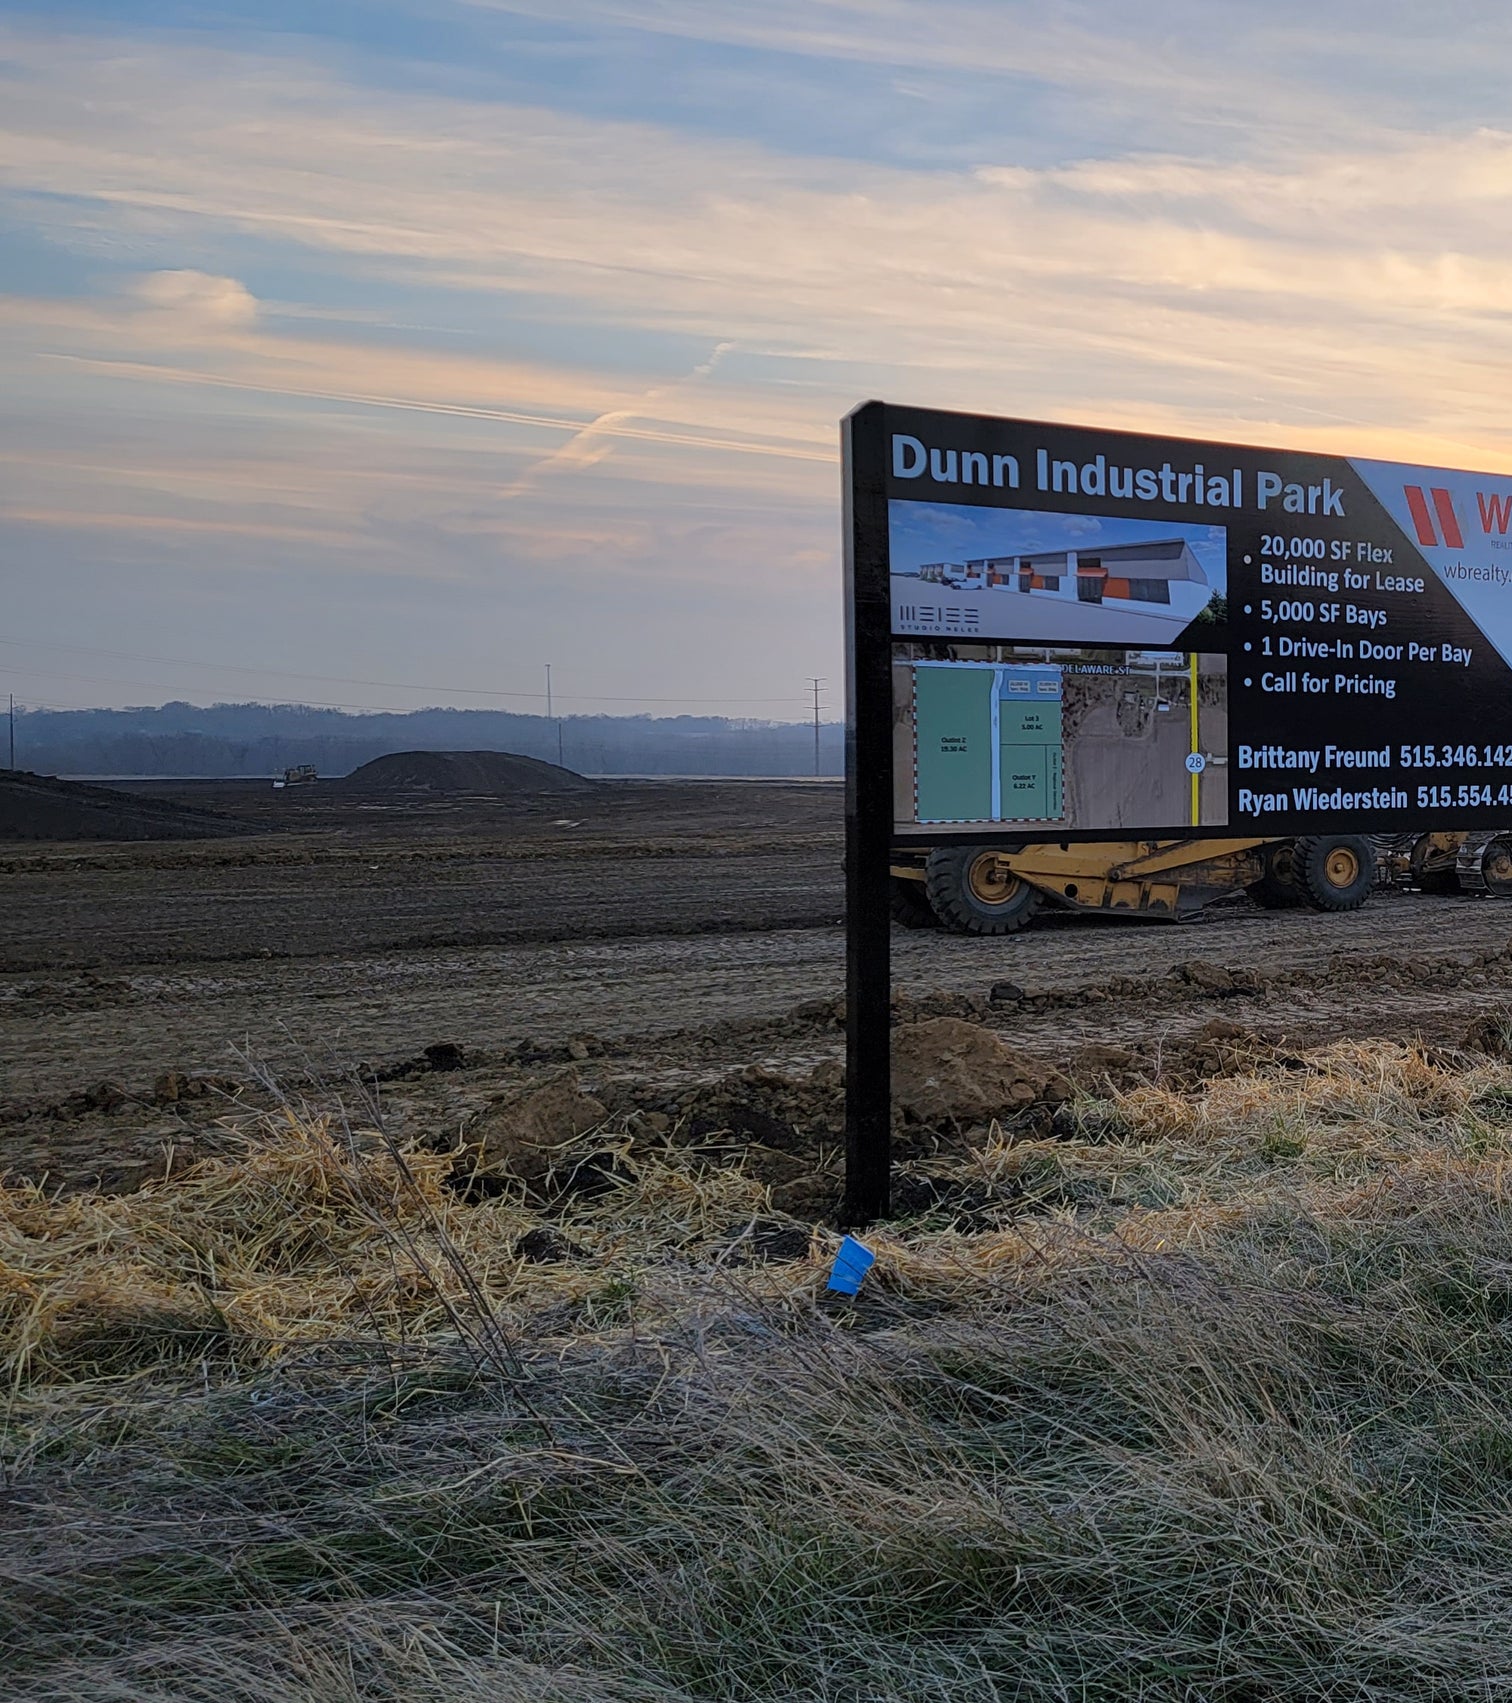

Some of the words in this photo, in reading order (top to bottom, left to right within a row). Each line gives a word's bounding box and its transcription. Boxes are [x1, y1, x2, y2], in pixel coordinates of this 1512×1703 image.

[891, 433, 1020, 489] Dunn
[1036, 448, 1242, 508] Industrial
[1256, 470, 1346, 517] Park
[1260, 534, 1325, 561] 20,000
[1330, 540, 1352, 562] SF
[1356, 542, 1393, 564] Flex
[1261, 563, 1339, 592] Building
[1343, 570, 1371, 590] for
[1376, 571, 1425, 594] Lease
[900, 624, 941, 632] STUDIO
[1261, 600, 1315, 625] 5,000
[1319, 602, 1341, 623] SF
[1346, 604, 1387, 630] Bays
[1262, 636, 1272, 656] 1
[1278, 636, 1354, 660] Drive-In
[1359, 640, 1404, 661] Door
[1408, 642, 1437, 662] Per
[1442, 643, 1472, 667] Bay
[1062, 663, 1115, 675] DELAWARE
[1118, 666, 1131, 676] ST
[1261, 671, 1297, 693] Call
[1302, 671, 1329, 693] for
[1334, 674, 1396, 699] Pricing
[1188, 757, 1202, 769] 28
[1238, 744, 1319, 774] Brittany
[1325, 745, 1391, 769] Freund
[1238, 788, 1288, 817] Ryan
[1293, 786, 1408, 811] Wiederstein
